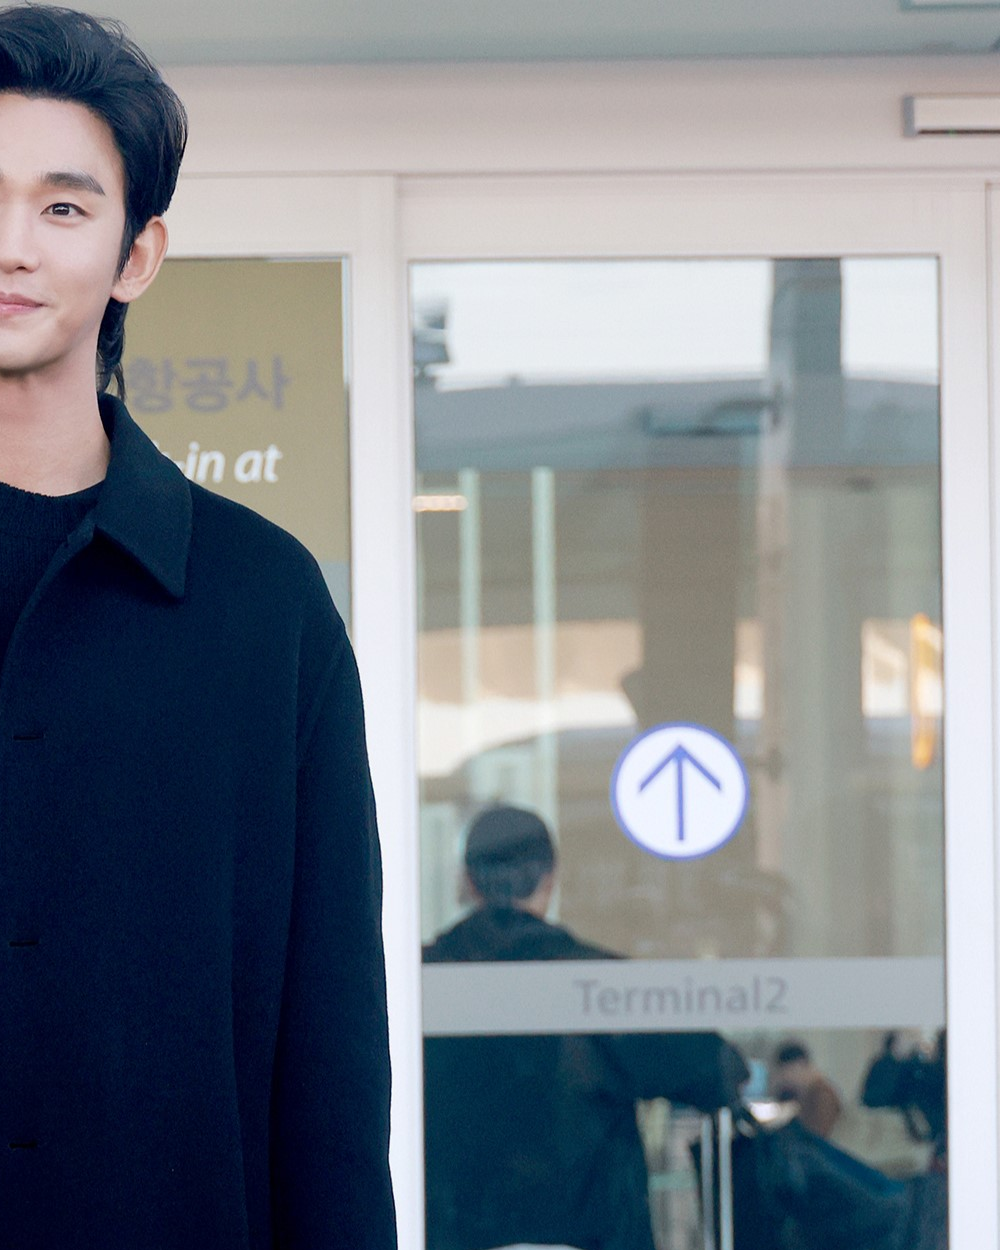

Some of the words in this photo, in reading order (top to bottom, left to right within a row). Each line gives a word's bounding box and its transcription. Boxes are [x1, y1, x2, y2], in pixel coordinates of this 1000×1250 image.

[128, 355, 291, 415] 항공사
[234, 443, 283, 484] at
[573, 976, 789, 1017] Terminal2
